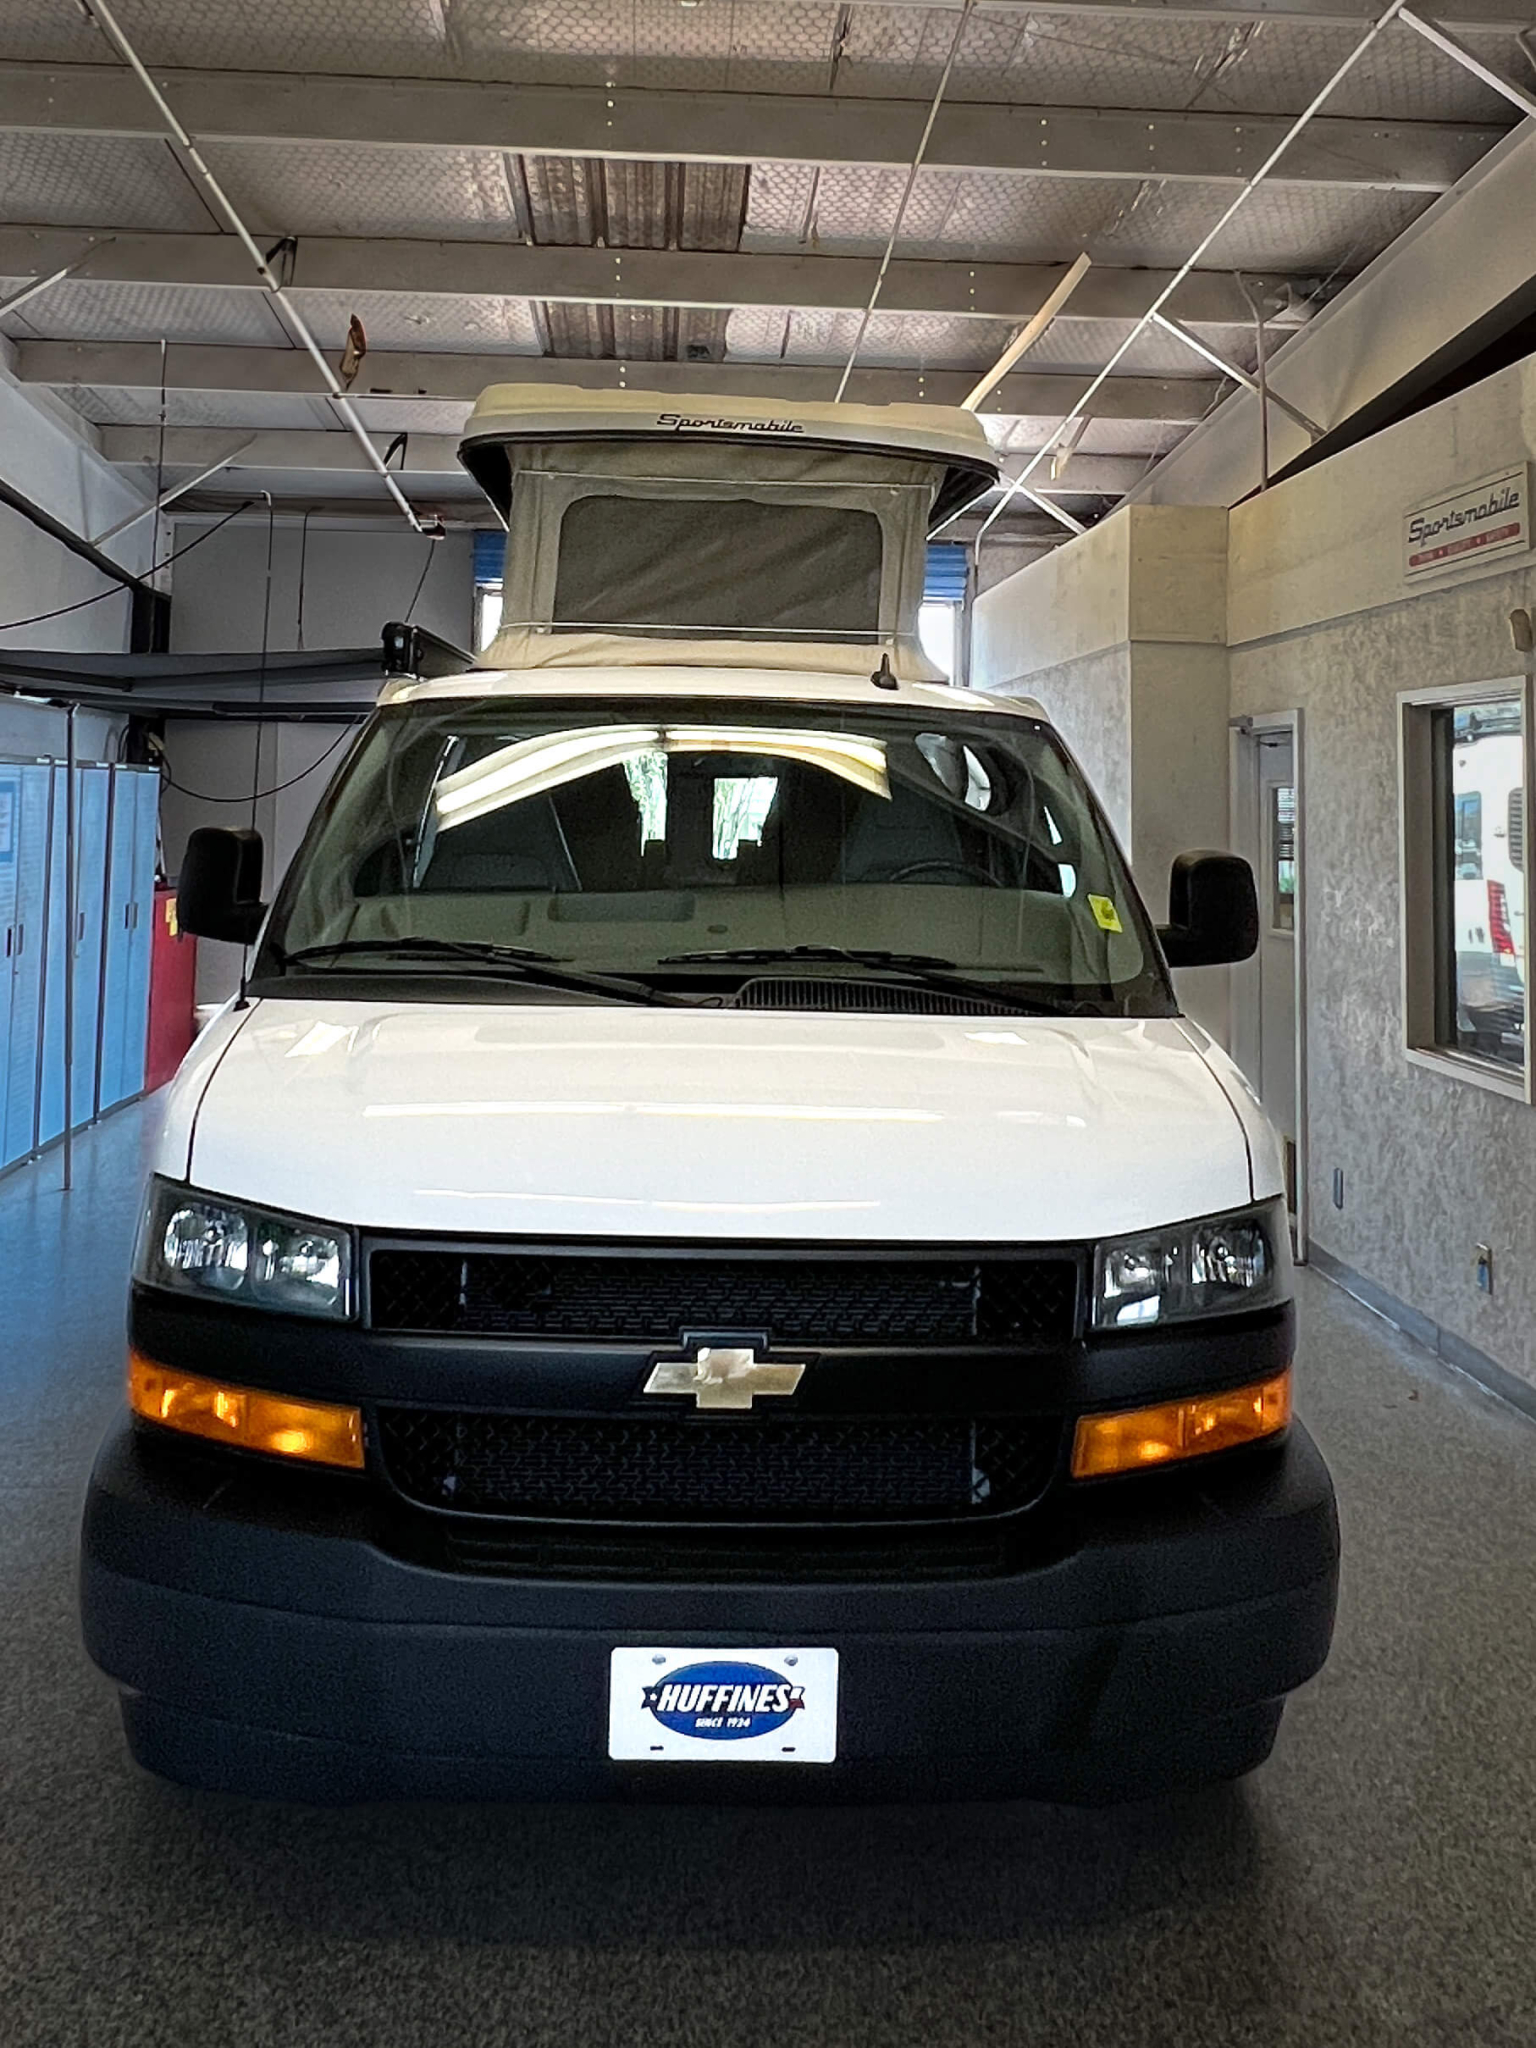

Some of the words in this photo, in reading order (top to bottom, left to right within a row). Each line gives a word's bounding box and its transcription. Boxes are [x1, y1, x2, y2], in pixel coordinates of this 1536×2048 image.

[657, 413, 804, 433] Sportsmobile
[1408, 487, 1520, 546] Sportsmobile
[657, 1684, 791, 1712] HUFFINES
[695, 1717, 723, 1728] SINCE
[727, 1717, 751, 1728] 1924
